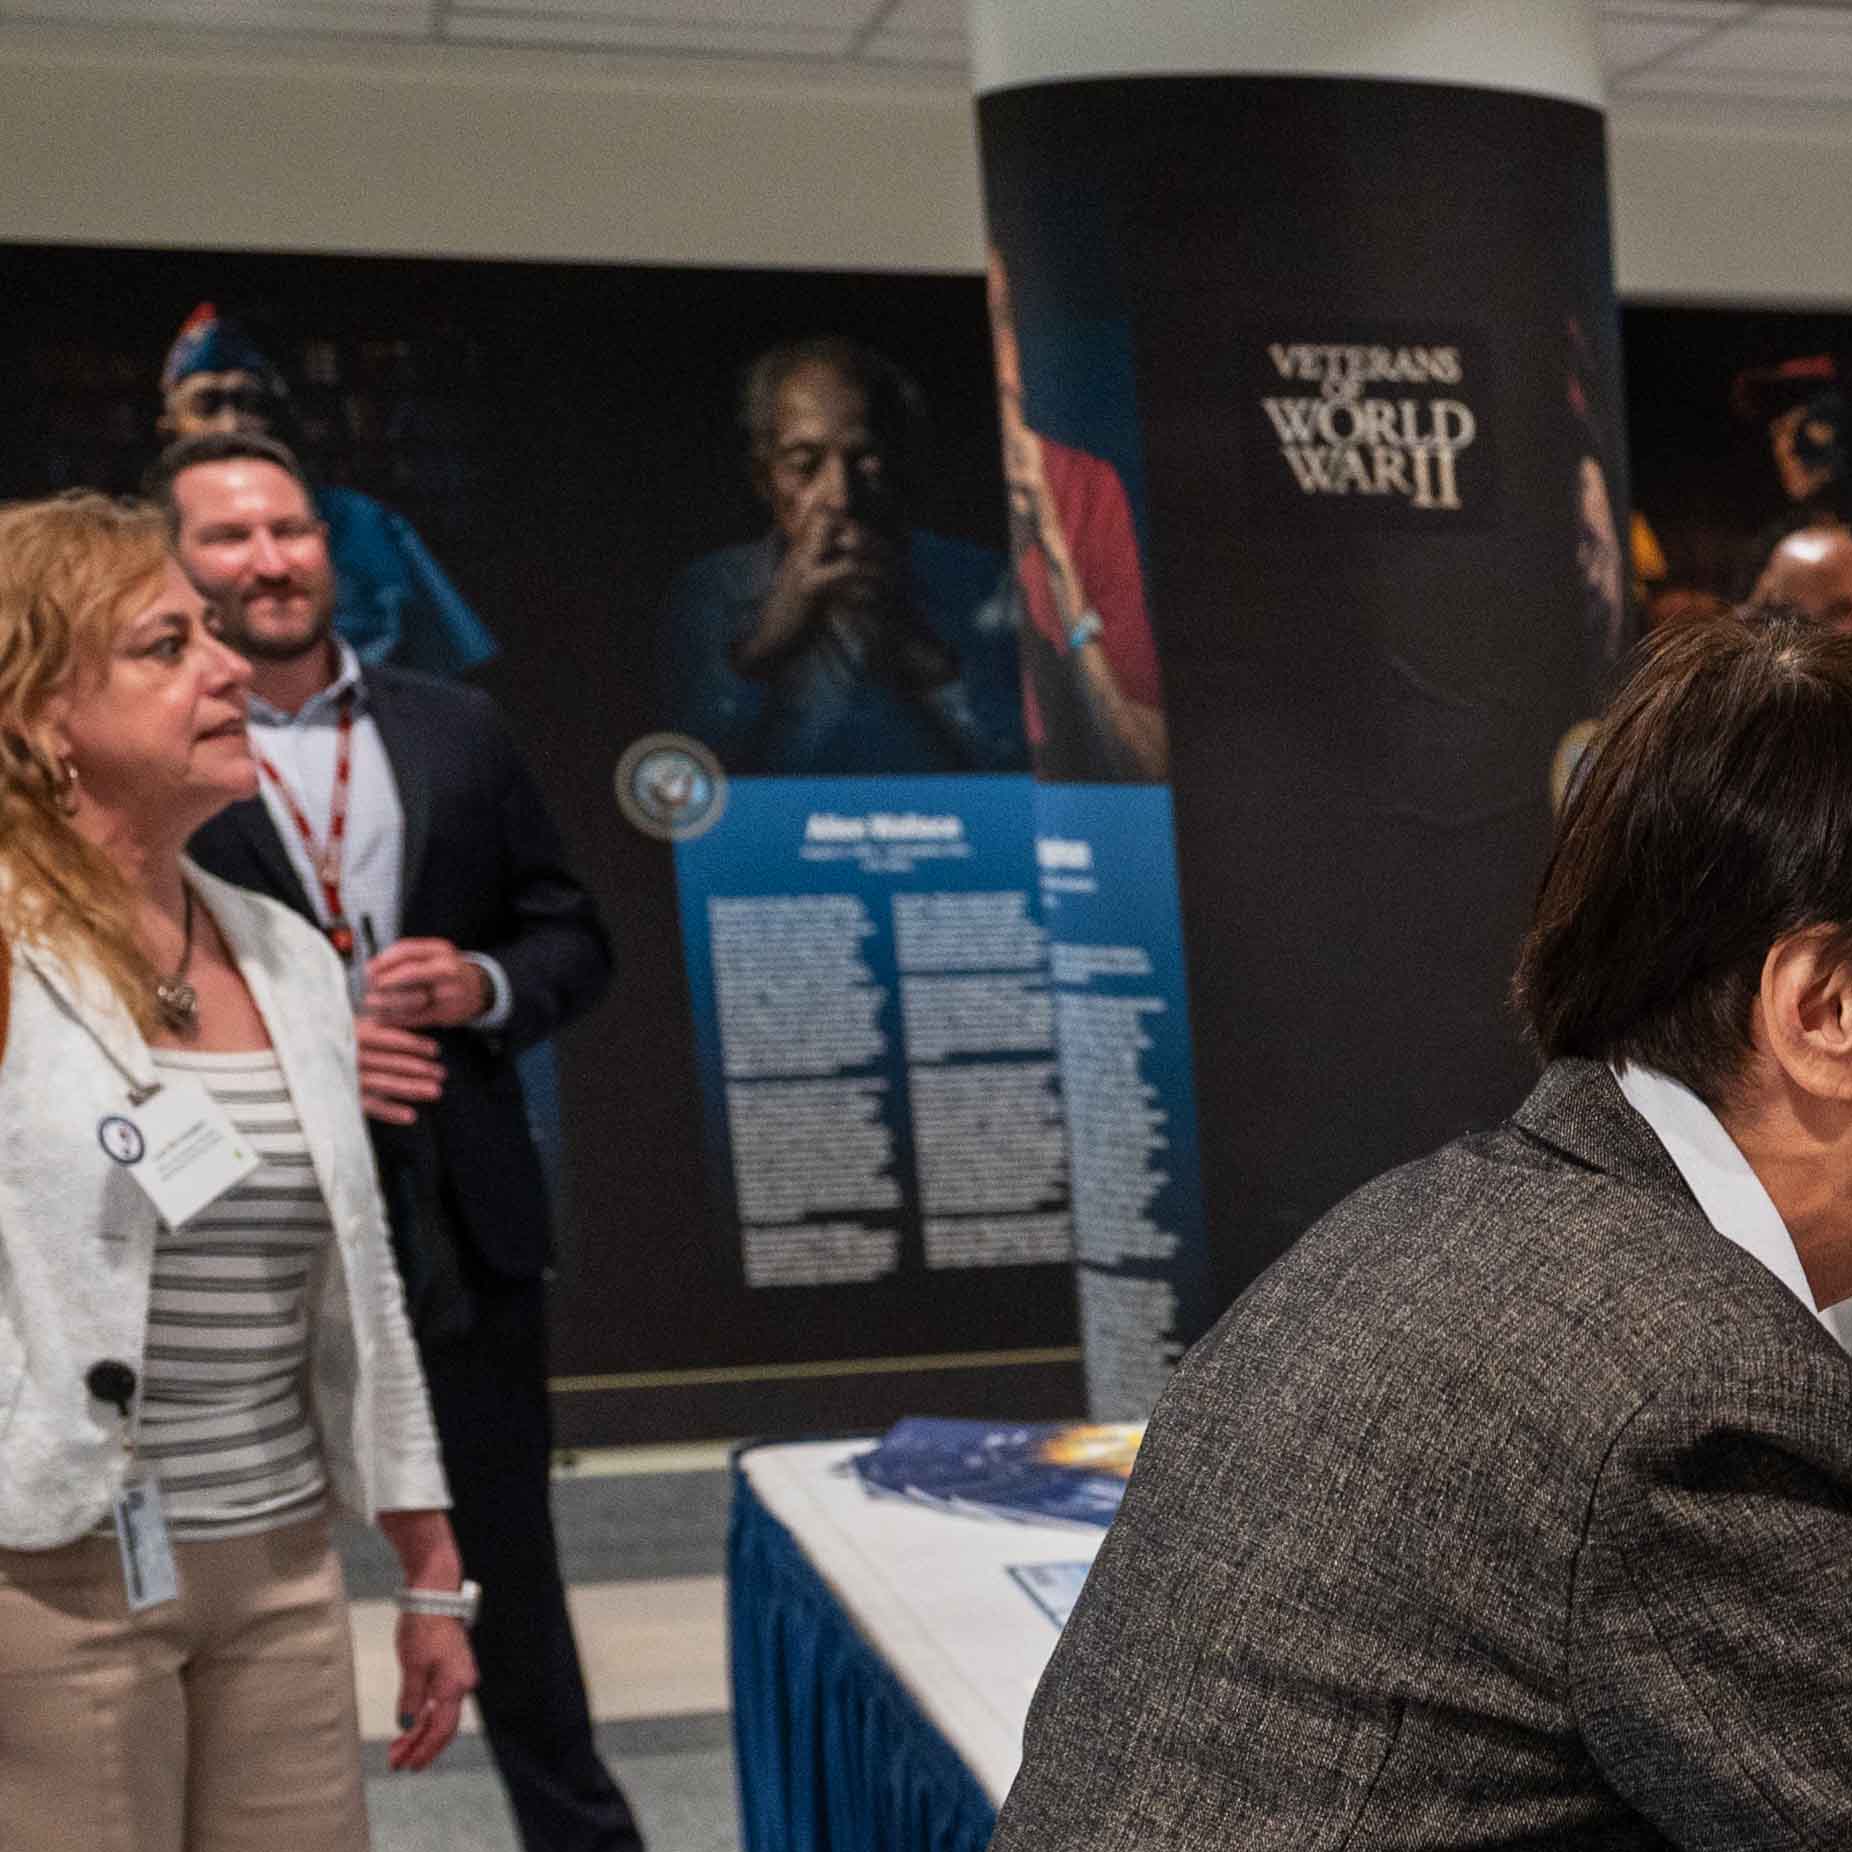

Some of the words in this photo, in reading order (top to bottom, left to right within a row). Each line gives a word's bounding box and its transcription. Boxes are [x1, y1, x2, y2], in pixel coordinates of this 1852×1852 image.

[1268, 343, 1461, 383] VETERANS
[1262, 398, 1477, 450] WORLD
[1286, 447, 1414, 495] WAR
